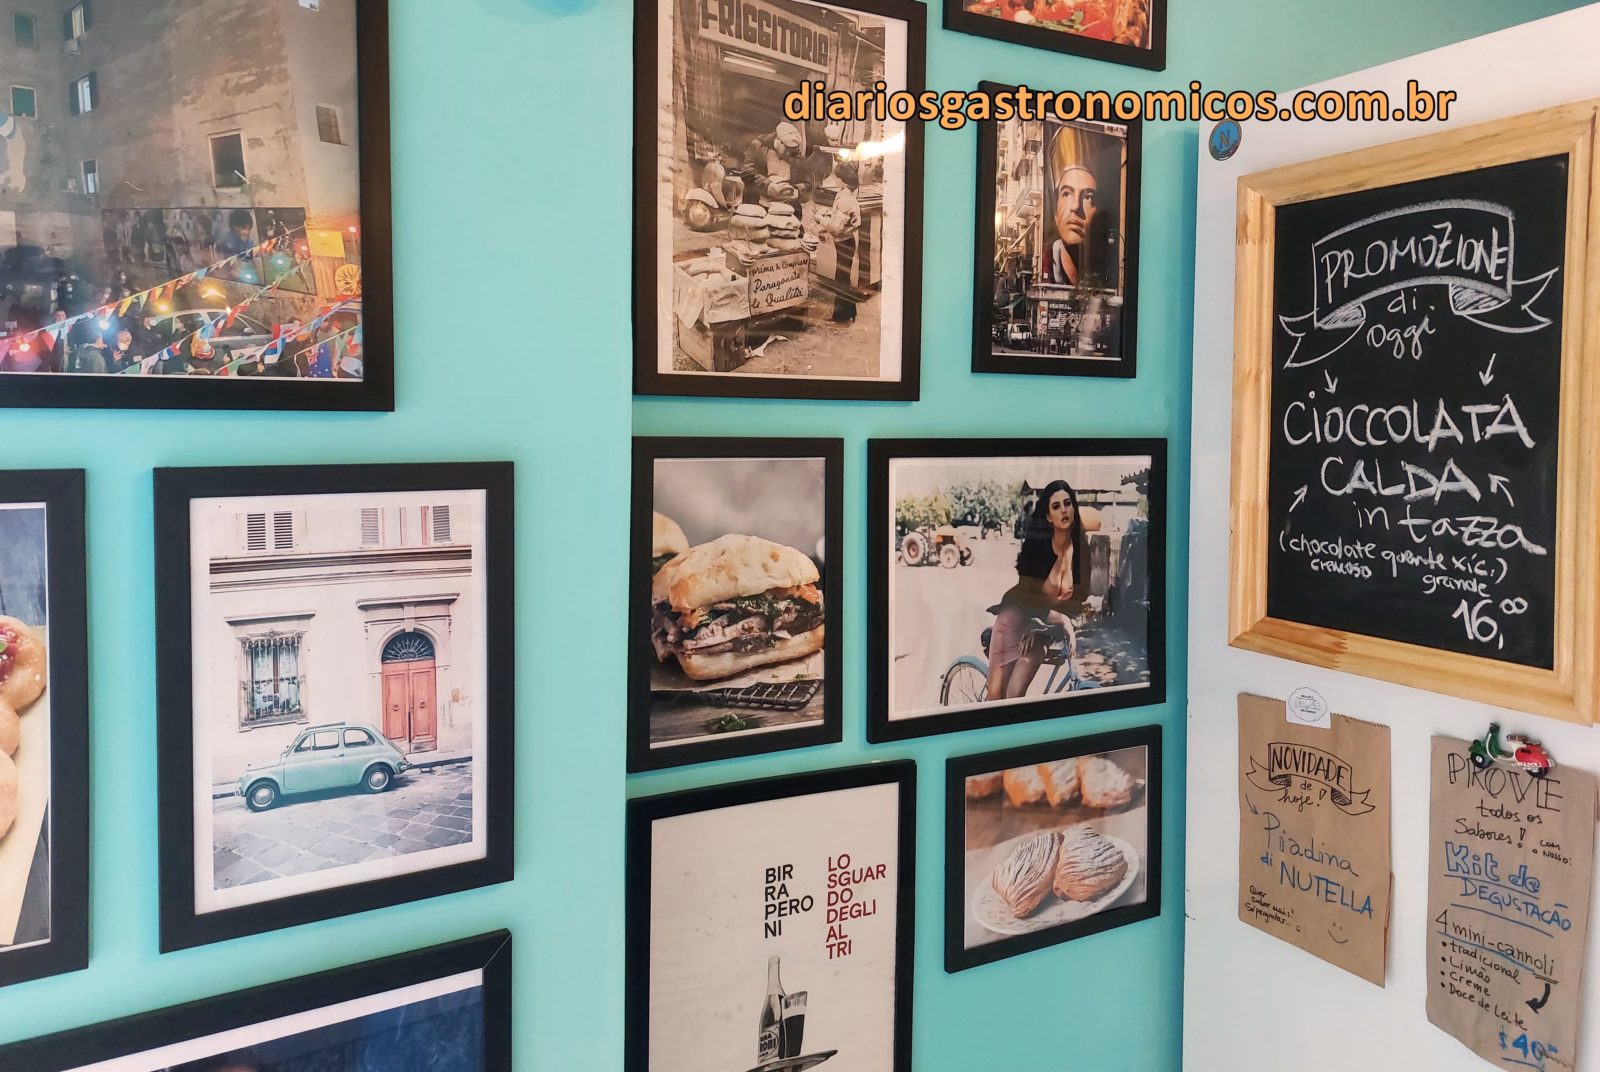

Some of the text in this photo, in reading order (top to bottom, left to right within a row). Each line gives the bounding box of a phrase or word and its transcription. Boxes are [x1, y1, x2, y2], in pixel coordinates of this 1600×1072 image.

[1321, 221, 1510, 304] PROMOZIONE
[1320, 456, 1482, 506] CALDA
[1353, 501, 1548, 556] in tazza
[1422, 573, 1491, 597] grande
[1271, 747, 1350, 792] NOVIDADE
[1447, 752, 1564, 813] PROVE
[1300, 780, 1313, 791] de
[1476, 798, 1543, 824] todos os
[1263, 812, 1360, 878] Piadina
[765, 863, 794, 885] BIR
[828, 853, 851, 872] LO
[1445, 841, 1541, 894] Kit de
[827, 863, 887, 889] SGUAR
[1260, 852, 1374, 920] di NUTELLA
[765, 883, 790, 902] RA
[827, 887, 854, 907] DO
[765, 895, 814, 921] PERO
[826, 899, 877, 924] DEGLI
[764, 920, 782, 939] NI
[826, 924, 848, 942] AL
[1435, 908, 1555, 976] 4 mini-cannoli
[826, 939, 852, 960] TRI
[1450, 940, 1521, 985] tradicional
[1449, 956, 1491, 984] Limão
[1449, 983, 1476, 1003] Doce
[1478, 997, 1491, 1011] de
